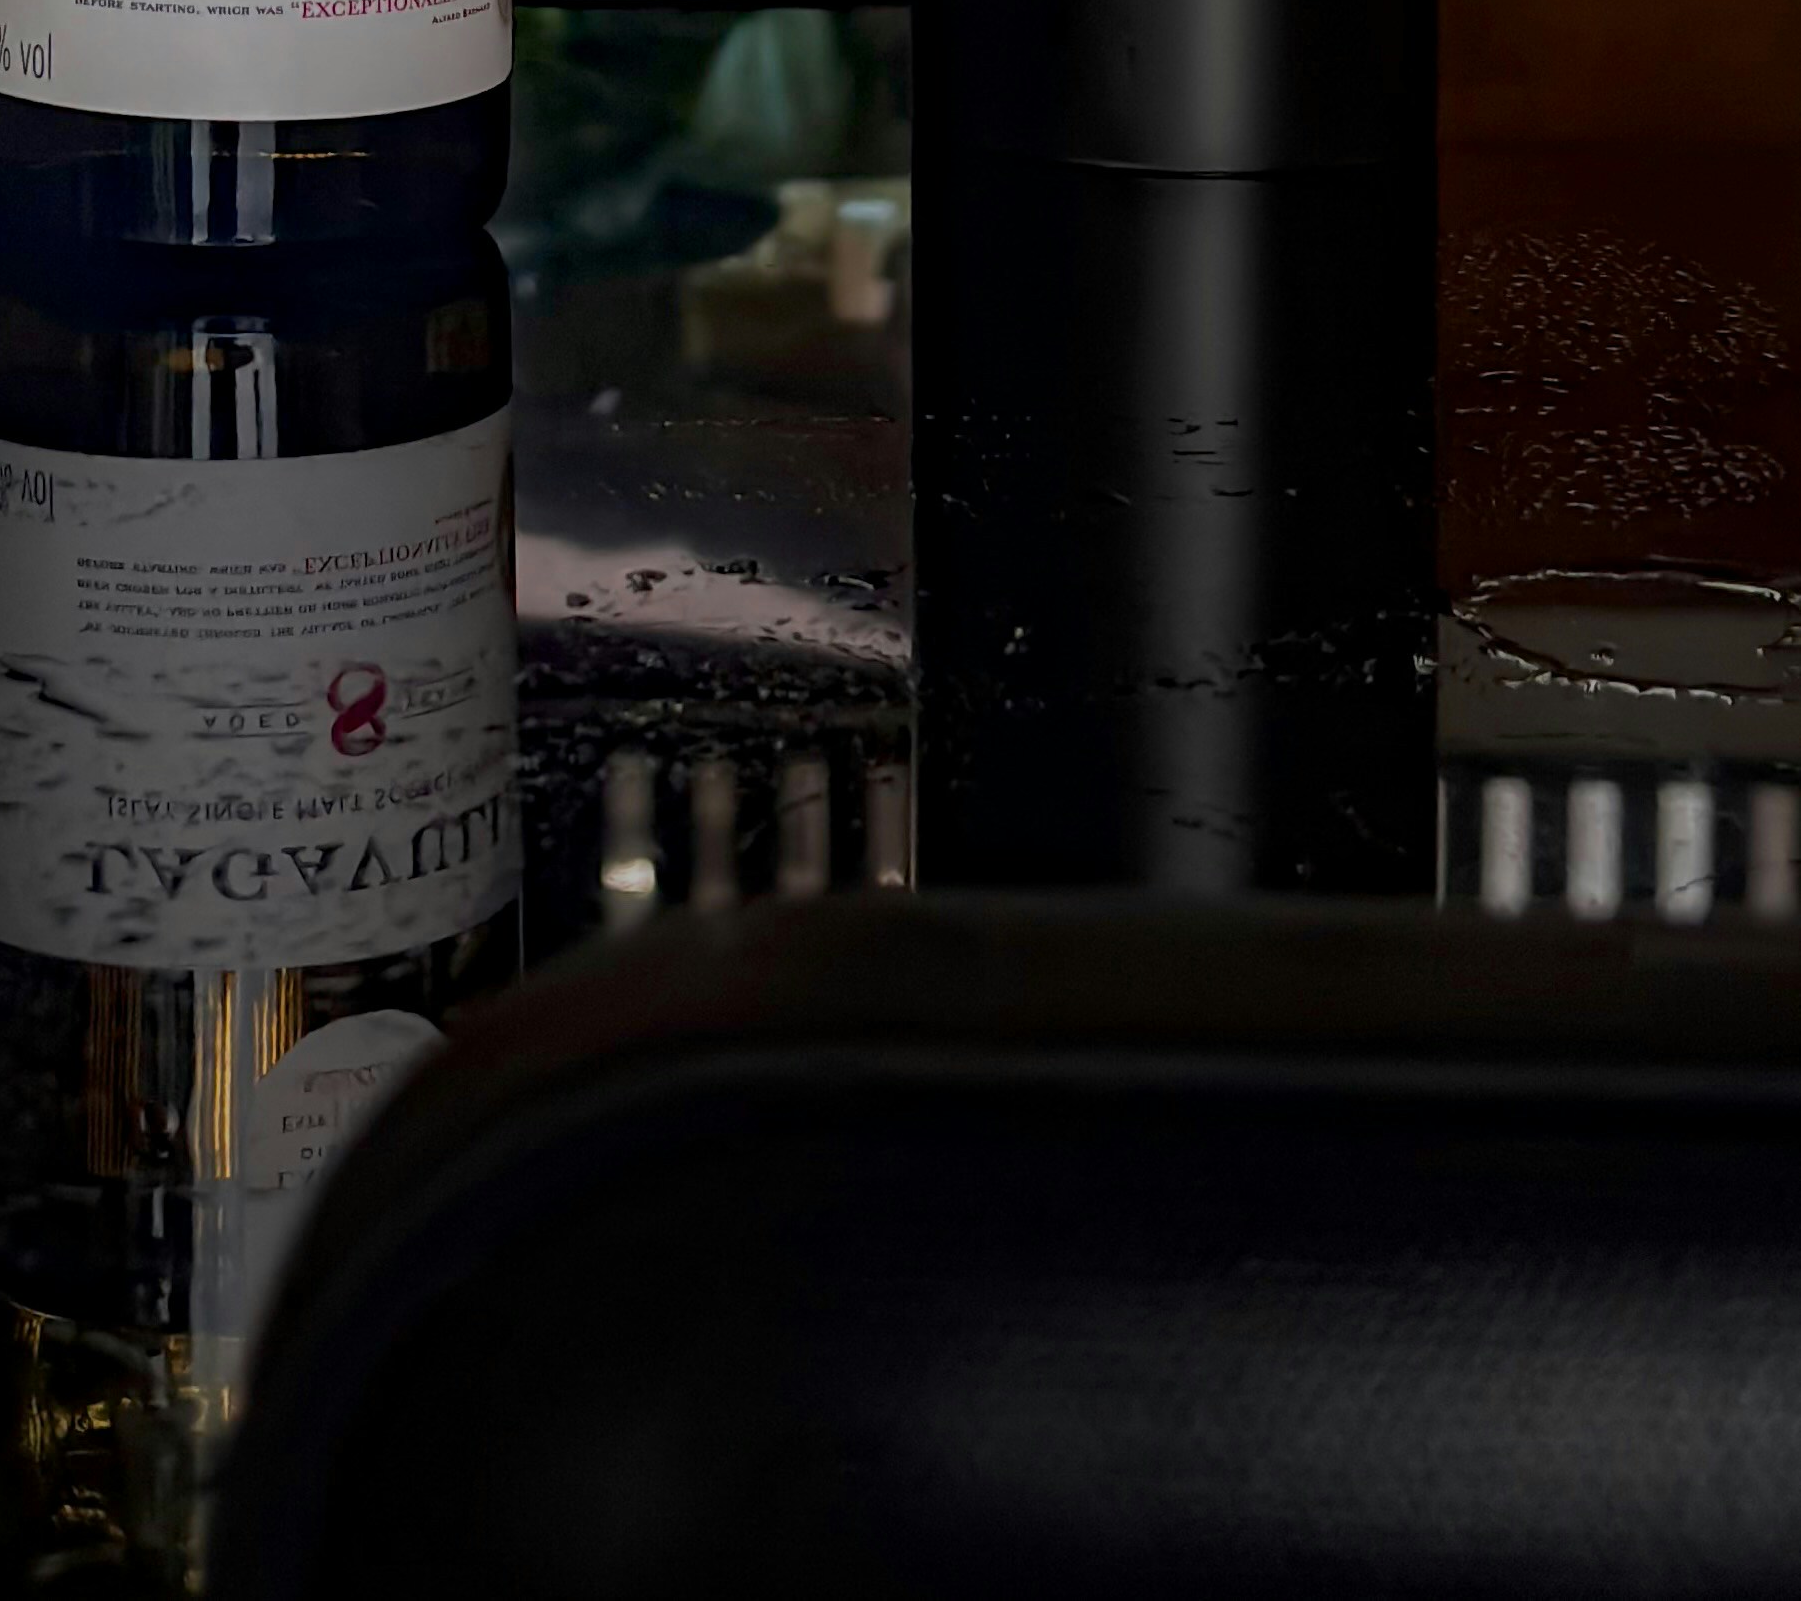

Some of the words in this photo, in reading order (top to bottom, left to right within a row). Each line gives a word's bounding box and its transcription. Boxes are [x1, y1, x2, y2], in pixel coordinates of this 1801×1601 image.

[207, 5, 249, 16] WHICH
[256, 5, 284, 15] WAS
[21, 32, 52, 80] vol
